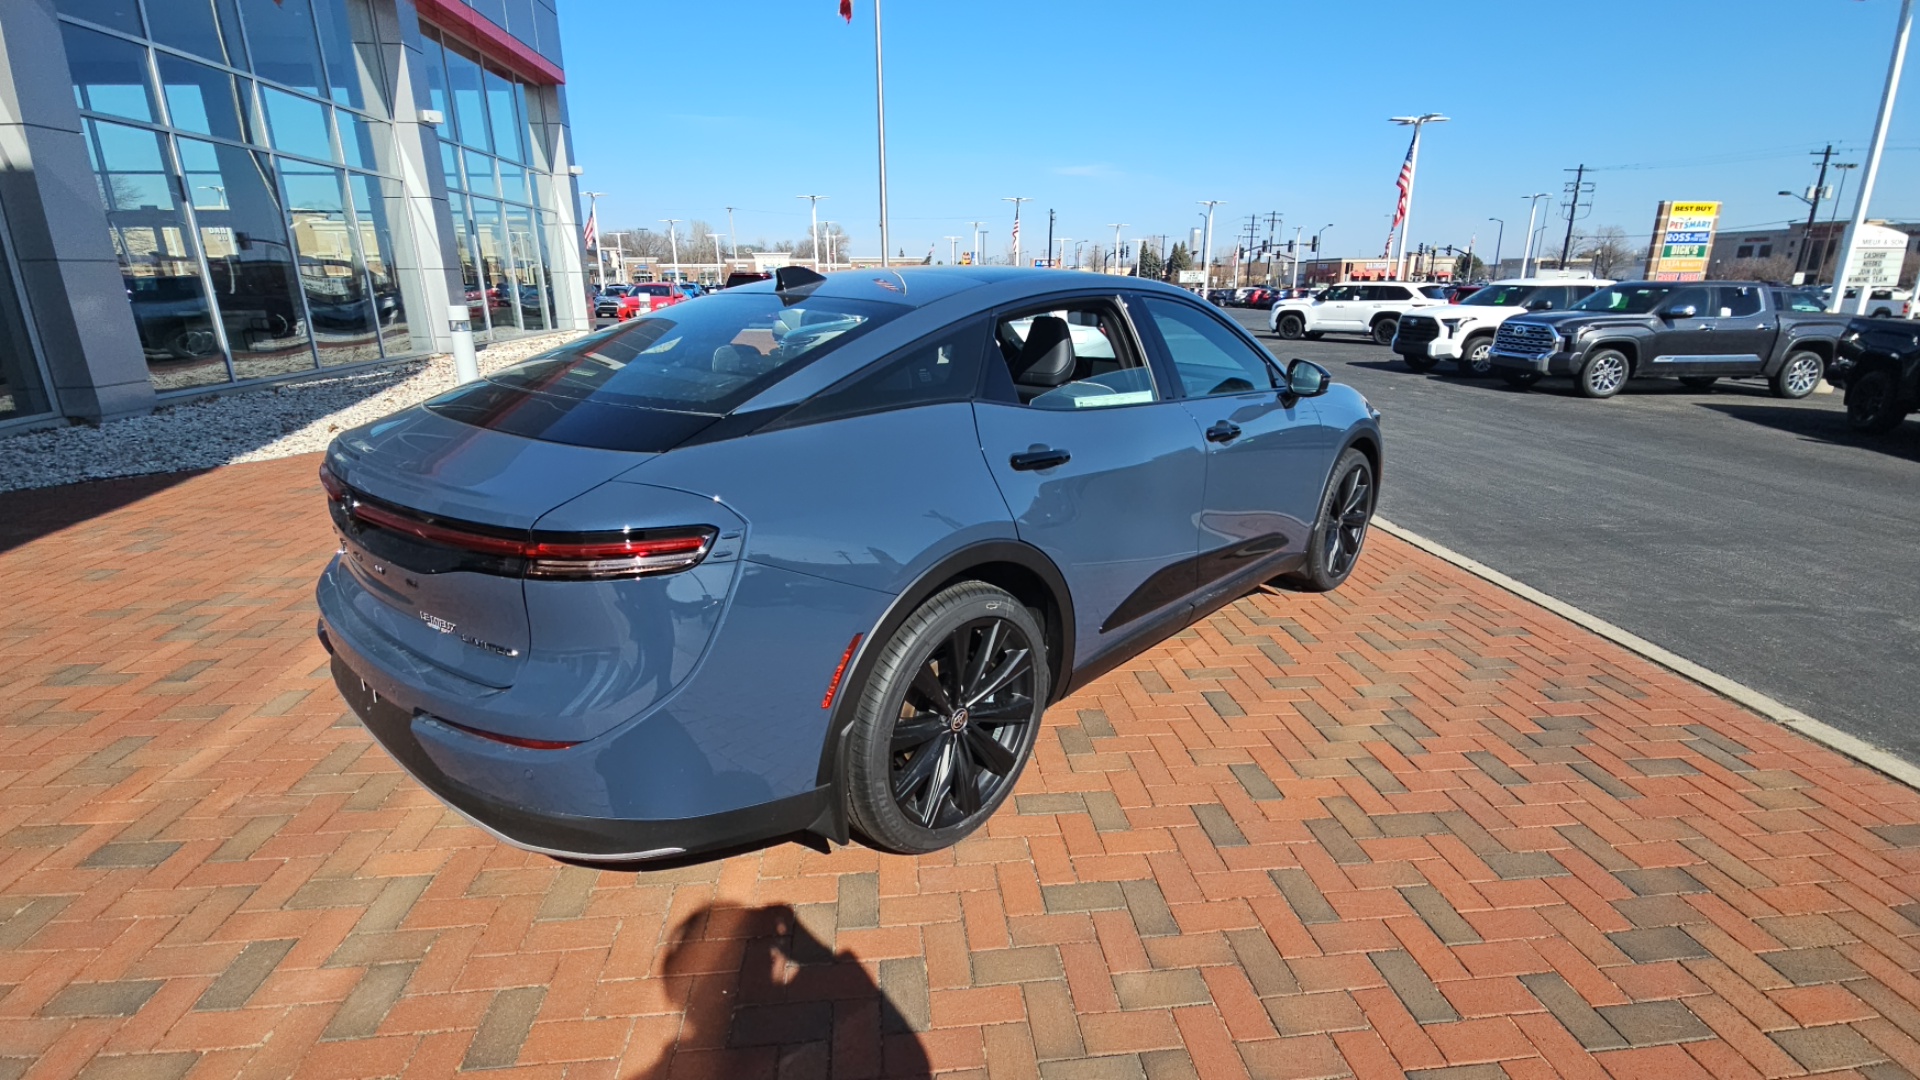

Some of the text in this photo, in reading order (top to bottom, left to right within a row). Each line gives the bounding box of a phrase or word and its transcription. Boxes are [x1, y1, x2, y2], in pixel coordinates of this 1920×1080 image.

[1669, 220, 1712, 229] PETSMART
[1666, 233, 1691, 242] ROSS
[1670, 246, 1700, 255] DICK'S
